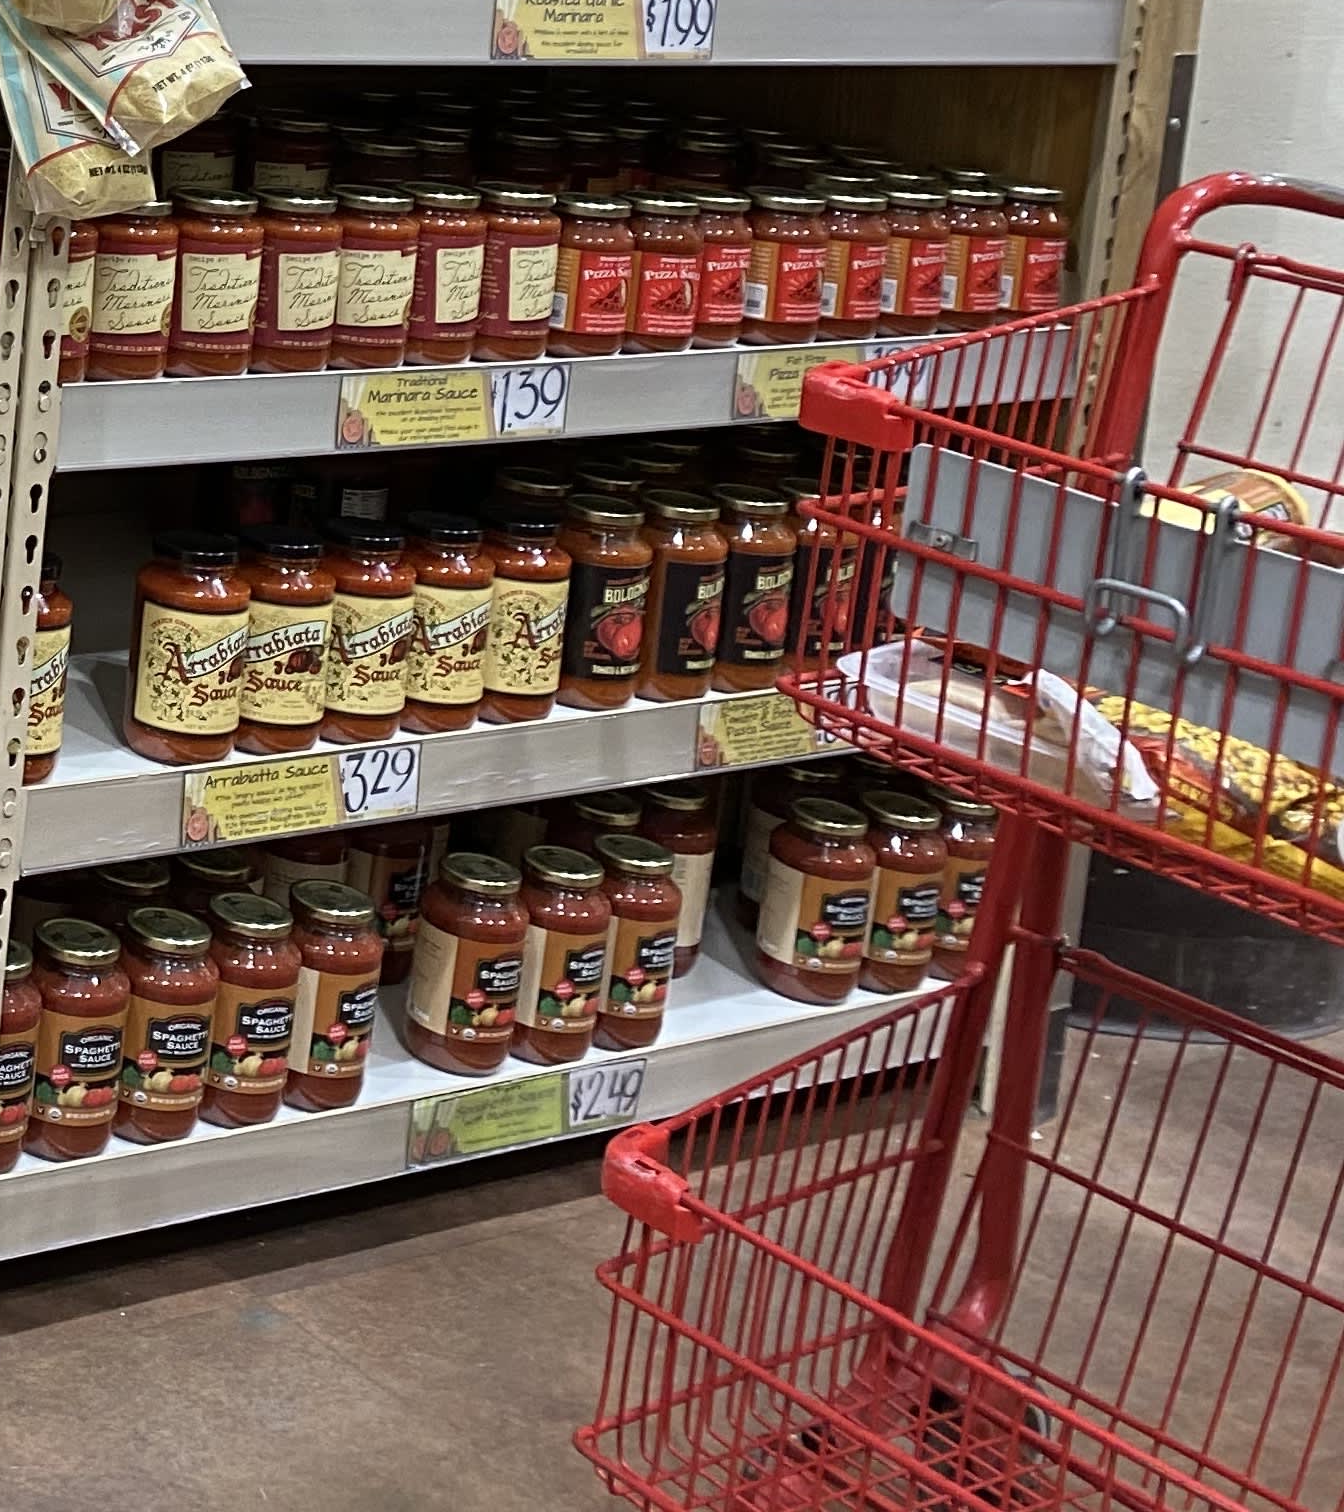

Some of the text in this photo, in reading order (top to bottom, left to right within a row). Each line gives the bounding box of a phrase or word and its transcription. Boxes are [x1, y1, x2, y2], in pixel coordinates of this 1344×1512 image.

[543, 8, 604, 23] Marinara
[367, 386, 479, 405] Marinara Sauce
[204, 762, 329, 789] Arrabiatta Sauce
[570, 1069, 643, 1122] $2.49
